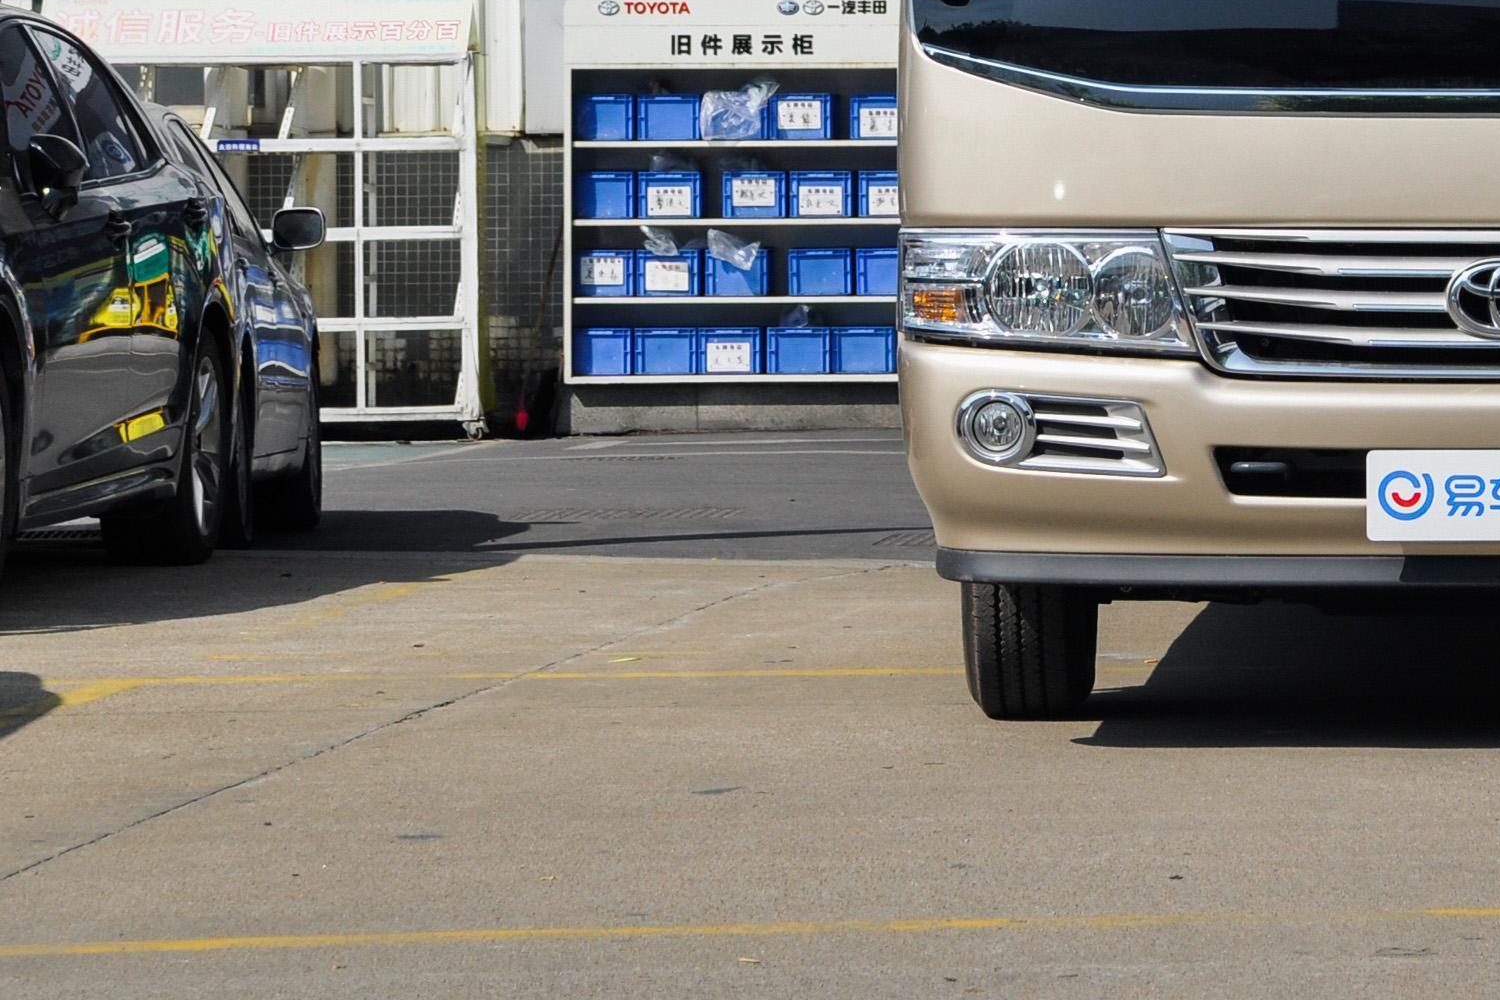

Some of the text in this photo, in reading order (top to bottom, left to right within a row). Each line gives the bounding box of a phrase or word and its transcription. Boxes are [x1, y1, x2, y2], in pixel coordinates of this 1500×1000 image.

[624, 2, 691, 14] TOYOTA
[827, 0, 887, 14] 一汽丰田
[670, 34, 815, 55] 旧件展示柜
